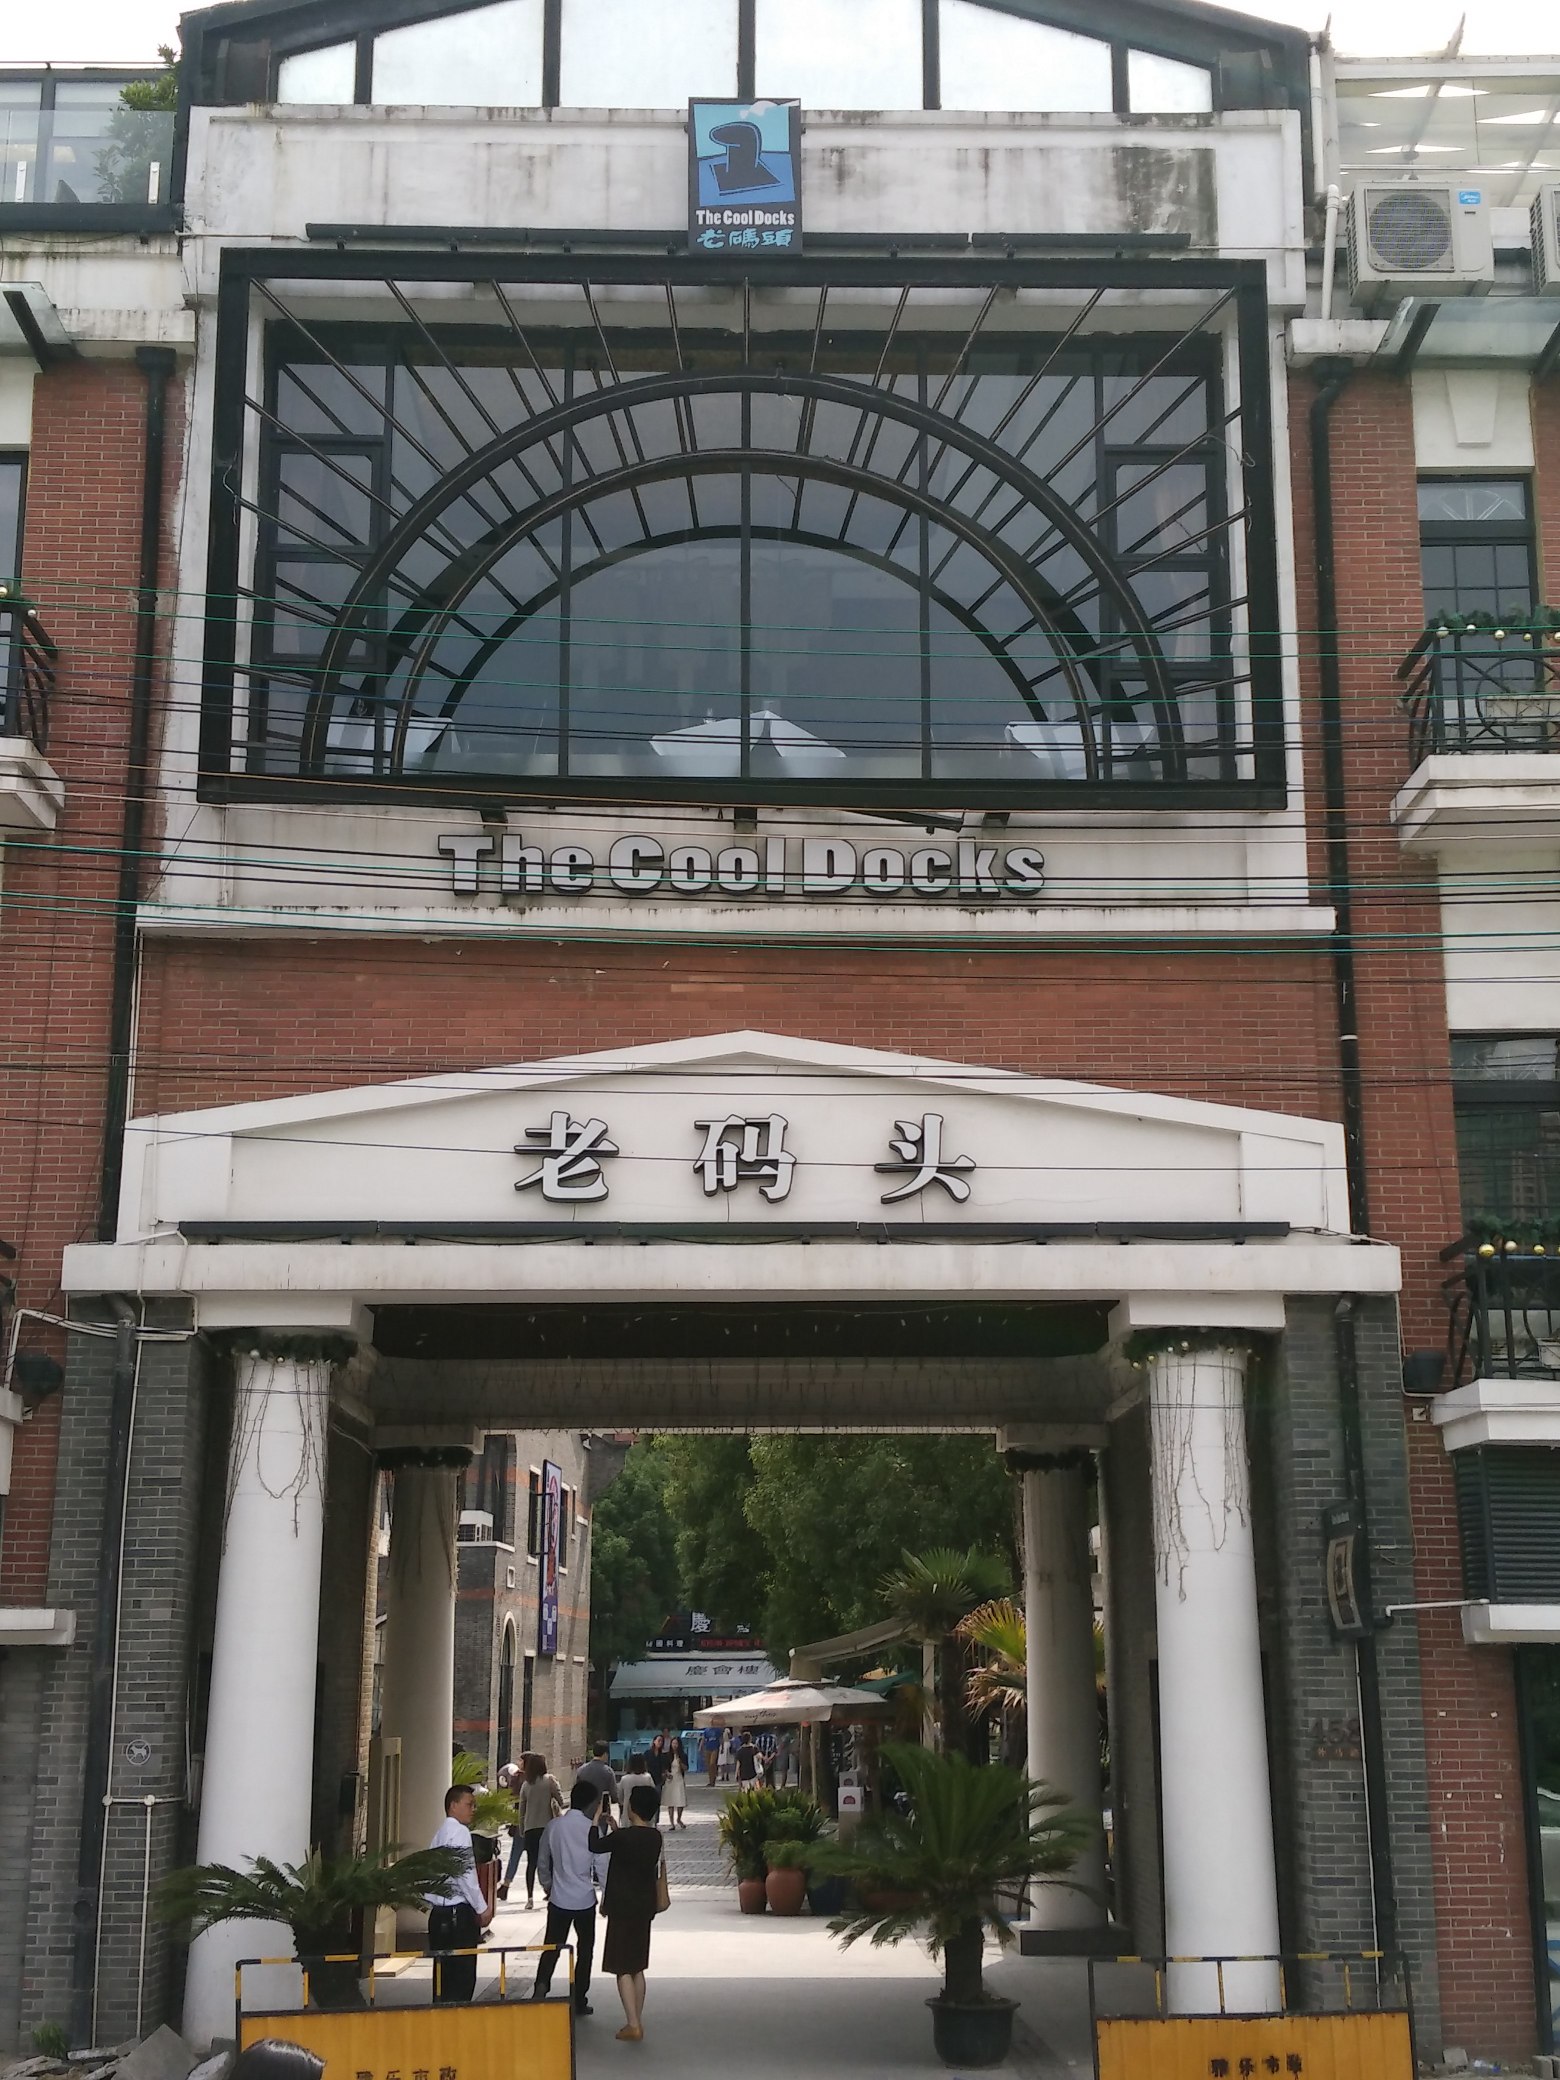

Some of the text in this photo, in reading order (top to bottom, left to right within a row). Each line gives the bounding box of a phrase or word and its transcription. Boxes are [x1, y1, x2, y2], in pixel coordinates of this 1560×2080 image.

[696, 209, 795, 225] The Cool Docks
[438, 834, 1046, 897] The Cool Docks
[514, 1110, 977, 1205] 老码头
